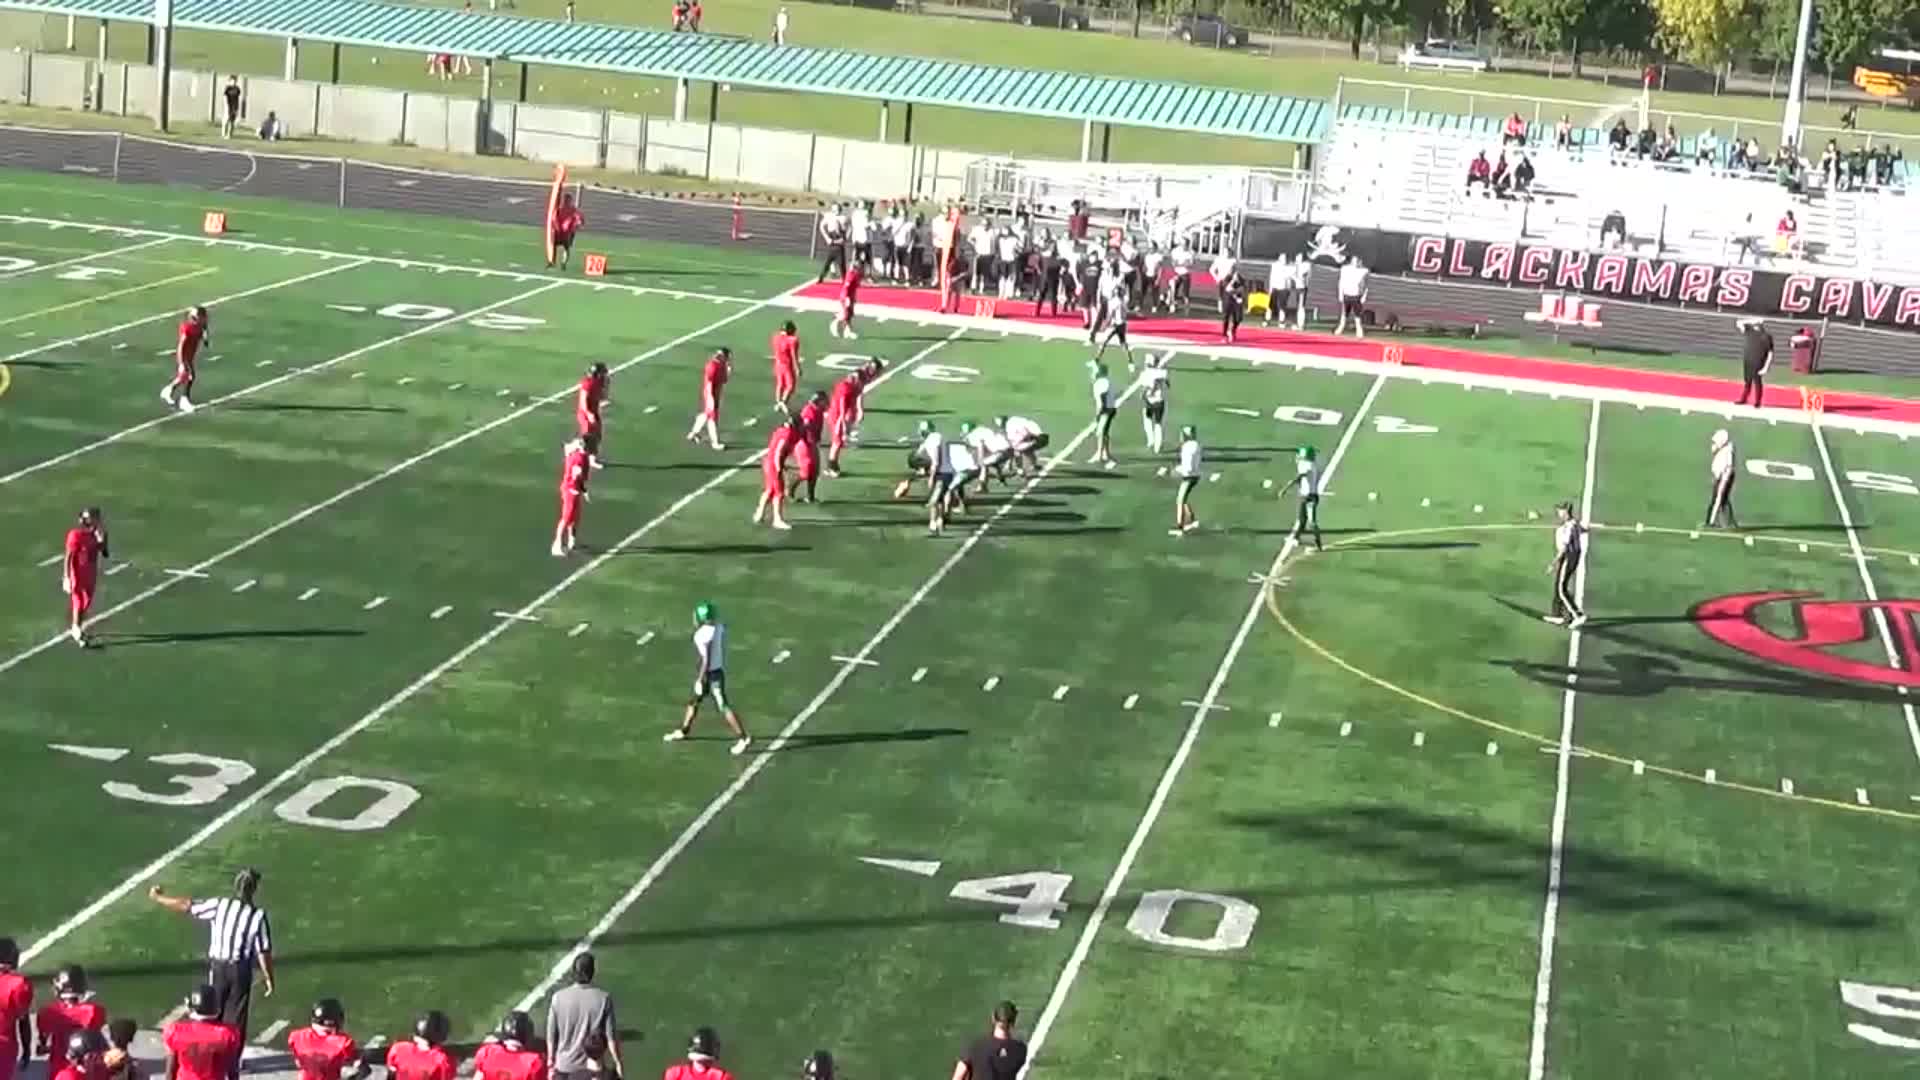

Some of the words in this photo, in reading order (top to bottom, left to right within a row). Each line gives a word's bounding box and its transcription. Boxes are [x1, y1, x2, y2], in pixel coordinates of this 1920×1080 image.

[588, 255, 604, 273] 20
[1413, 236, 1753, 306] CLACKAMAS
[1780, 274, 1920, 325] CAVA
[102, 753, 422, 831] 30
[950, 871, 1259, 951] 40
